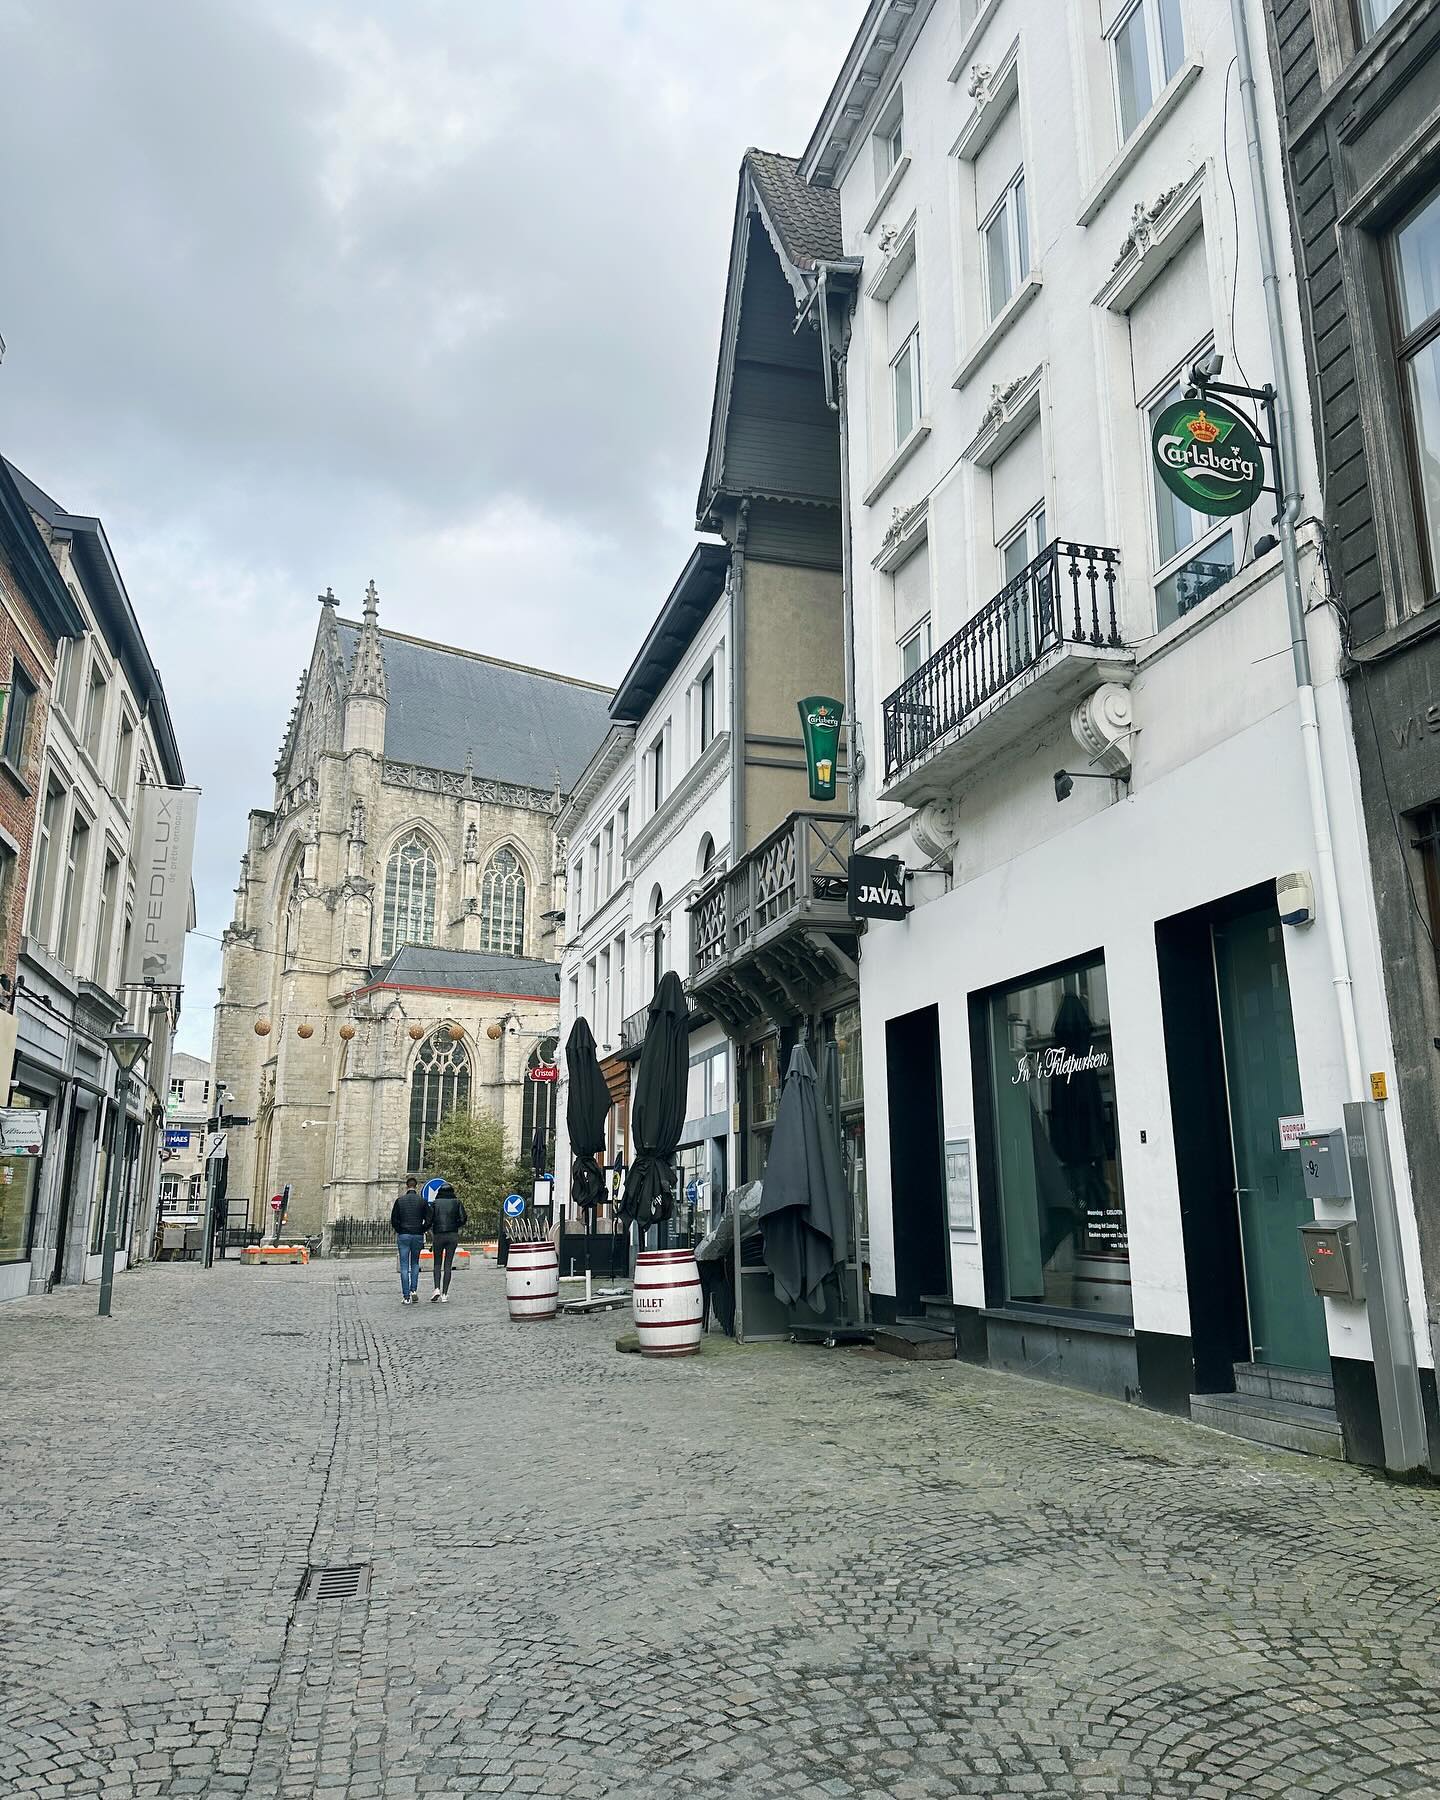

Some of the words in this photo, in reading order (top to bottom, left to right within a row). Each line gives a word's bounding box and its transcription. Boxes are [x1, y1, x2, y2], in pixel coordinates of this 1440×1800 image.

[1157, 434, 1254, 481] Carlsberg
[808, 714, 838, 727] Carlsberg
[145, 798, 173, 943] PEDILUX
[857, 885, 903, 906] JAVA
[534, 1068, 554, 1078] Cristal
[1011, 1054, 1031, 1084] In
[1044, 1045, 1109, 1084] Filetpurken
[1308, 1160, 1319, 1177] 92
[636, 1298, 664, 1308] LILLET
